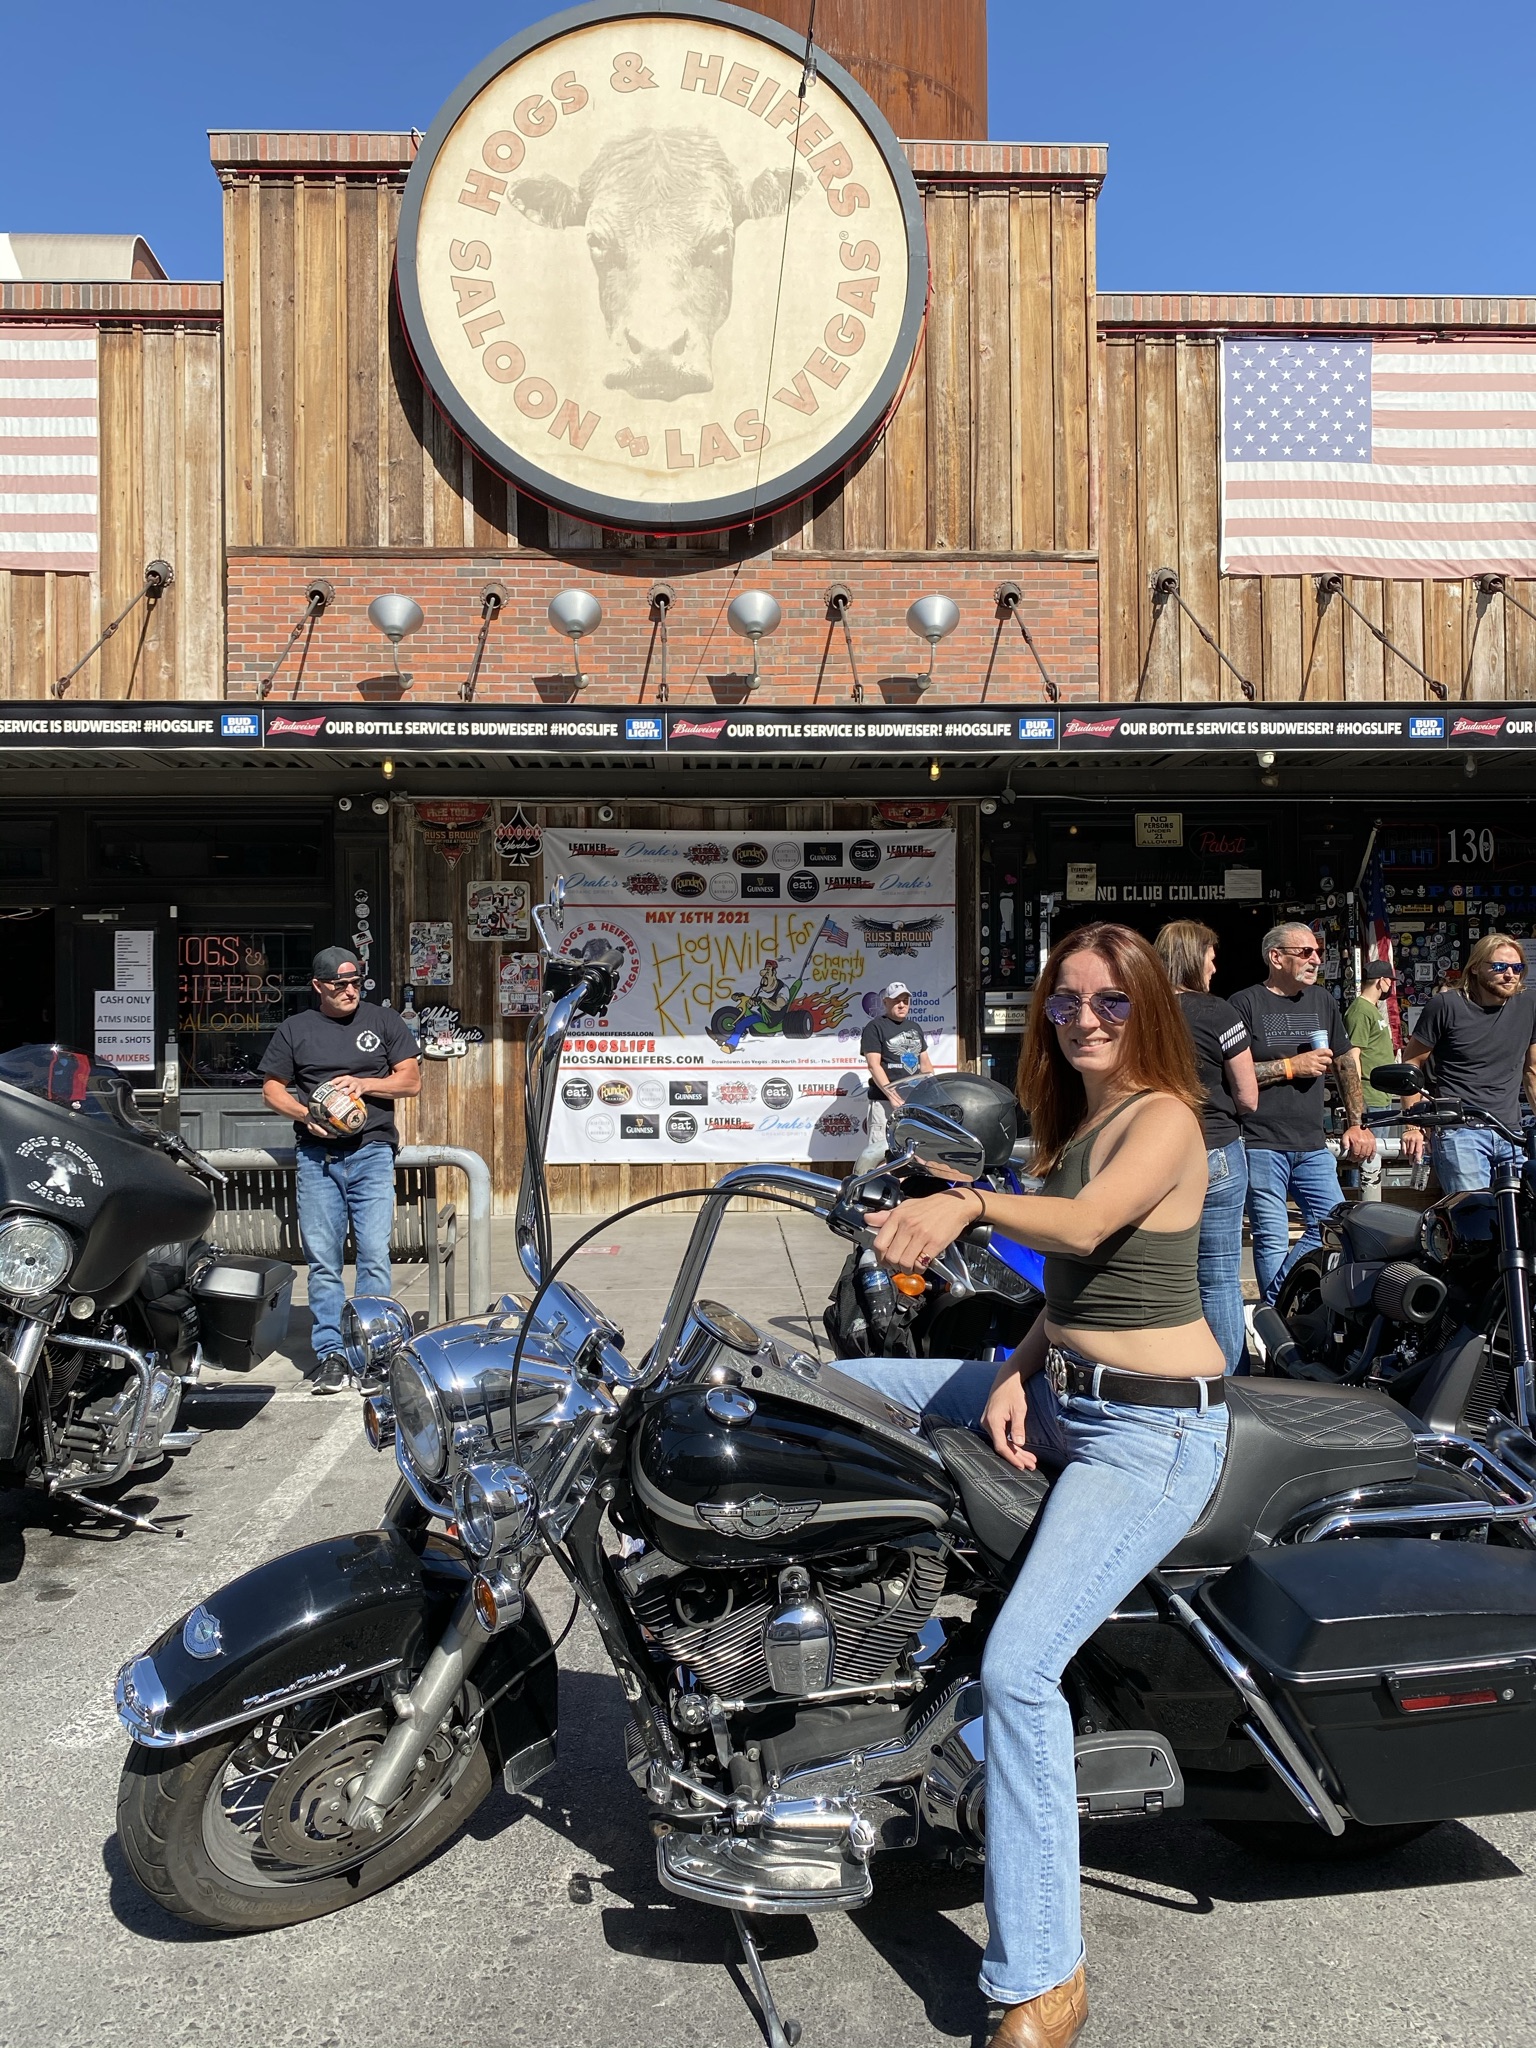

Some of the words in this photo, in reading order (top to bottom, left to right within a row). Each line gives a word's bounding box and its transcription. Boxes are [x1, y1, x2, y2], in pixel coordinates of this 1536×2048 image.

[458, 70, 589, 216] HOGS
[610, 51, 659, 93] &
[680, 50, 871, 218] HEIFERS
[449, 238, 601, 451] SALOON
[665, 409, 771, 470] LAS
[0, 719, 49, 734] SERVICE
[50, 720, 62, 734] IS
[64, 719, 142, 734] BUDWEISER!
[143, 719, 214, 734] #HOGSLIFE
[227, 717, 251, 726] BUD
[269, 718, 321, 734] Budweiser
[632, 721, 656, 730] BUD
[1025, 720, 1048, 729] BUD
[1065, 721, 1115, 734] Budweiser
[1415, 719, 1438, 728] BUD
[1453, 720, 1501, 733] Budweiser
[1506, 721, 1533, 735] OUR
[223, 725, 257, 735] LIGHT
[326, 721, 353, 735] OUR
[355, 721, 403, 735] BOTTLE
[405, 722, 455, 736] SERVICE
[457, 722, 469, 736] IS
[471, 722, 548, 736] BUDWEISER!
[550, 722, 618, 737] #HOGSLIFE
[628, 729, 659, 738] LIGHT
[672, 722, 722, 735] Budweiser
[727, 723, 754, 737] OUR
[756, 724, 801, 738] BOTTLE
[803, 724, 853, 737] SERVICE
[854, 724, 866, 737] IS
[867, 723, 942, 737] BUDWEISER!
[945, 723, 1011, 737] #HOGSLIFE
[1021, 728, 1053, 738] LIGHT
[1120, 723, 1147, 736] OUR
[1149, 722, 1195, 735] BOTTLE
[1196, 721, 1246, 735] SERVICE
[1248, 721, 1259, 734] IS
[1261, 721, 1334, 735] BUDWEISER!
[1336, 721, 1402, 735] #HOGSLIFE
[1411, 727, 1442, 737] LIGHT
[424, 831, 446, 839] RUSS
[449, 831, 479, 839] BROWN
[498, 827, 540, 838] KLOCK
[569, 842, 607, 851] LEATHER
[1199, 830, 1246, 853] Pabst
[1447, 828, 1495, 863] 130
[622, 841, 680, 858] Drake's
[855, 848, 876, 858] eat.
[887, 845, 923, 853] LEATHER
[564, 873, 619, 889] Drake's
[792, 879, 815, 890] eat.
[825, 876, 862, 885] LEATHER
[877, 874, 933, 891] Drake's
[1097, 886, 1117, 901] NO
[1123, 885, 1163, 901] CLUB
[645, 911, 674, 924] MAY
[679, 911, 714, 924] 16TH
[717, 911, 750, 924] 2021
[559, 927, 584, 955] HOGS
[587, 923, 597, 931] &
[601, 923, 638, 956] HEIFERS
[863, 931, 891, 942] RUSS
[894, 931, 933, 942] BROWN
[245, 947, 265, 966] &
[652, 932, 711, 987] Hog
[714, 914, 779, 975] Wild
[786, 913, 815, 954] for
[812, 949, 865, 978] charity
[619, 958, 640, 993] VEGAS
[812, 968, 856, 984] event
[179, 974, 283, 1003] EIFERS
[100, 995, 124, 1004] CASH
[126, 995, 151, 1004] ONLY
[652, 964, 736, 1039] Kids
[124, 1015, 151, 1023] INSIDE
[421, 1005, 459, 1024] Mix
[98, 1036, 117, 1044] BEER
[125, 1036, 151, 1044] SHOTS
[450, 1027, 483, 1041] Music
[562, 1039, 656, 1052] #HOGSLIFE
[100, 1054, 114, 1062] NO
[116, 1054, 150, 1062] MIXERS
[562, 1055, 704, 1065] HOGSANDHEIFERS.COM
[566, 1088, 589, 1098] eat.
[766, 1088, 789, 1097] eat.
[798, 1084, 835, 1092] LEATHER
[671, 1120, 693, 1130] eat.
[704, 1117, 741, 1125] LEATHER
[756, 1115, 813, 1131] Drake's
[626, 1126, 653, 1134] GUINNESS
